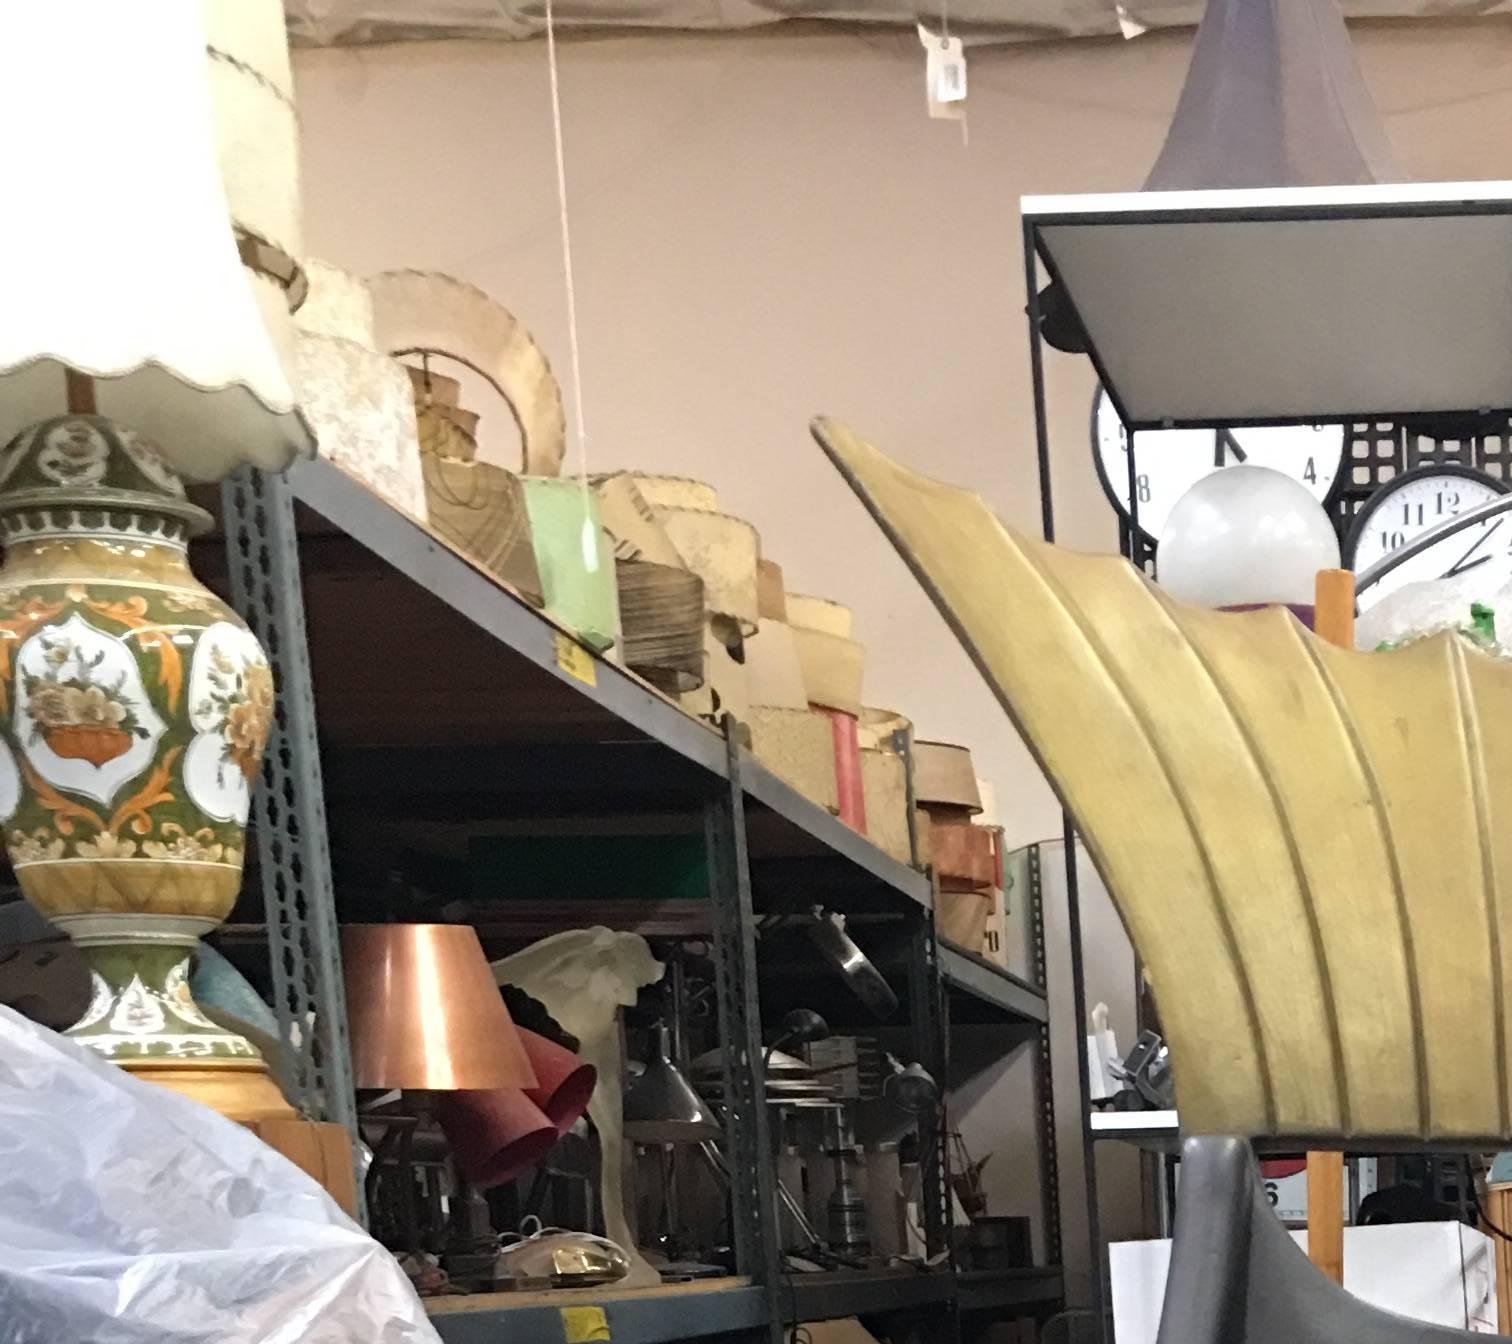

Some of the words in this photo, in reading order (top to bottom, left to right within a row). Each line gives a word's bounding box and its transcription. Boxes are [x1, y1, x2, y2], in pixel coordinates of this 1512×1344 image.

[1303, 457, 1317, 485] 4
[1136, 474, 1151, 503] 8
[1403, 503, 1424, 526] 11
[1436, 491, 1460, 516] 12
[1381, 530, 1405, 551] 10
